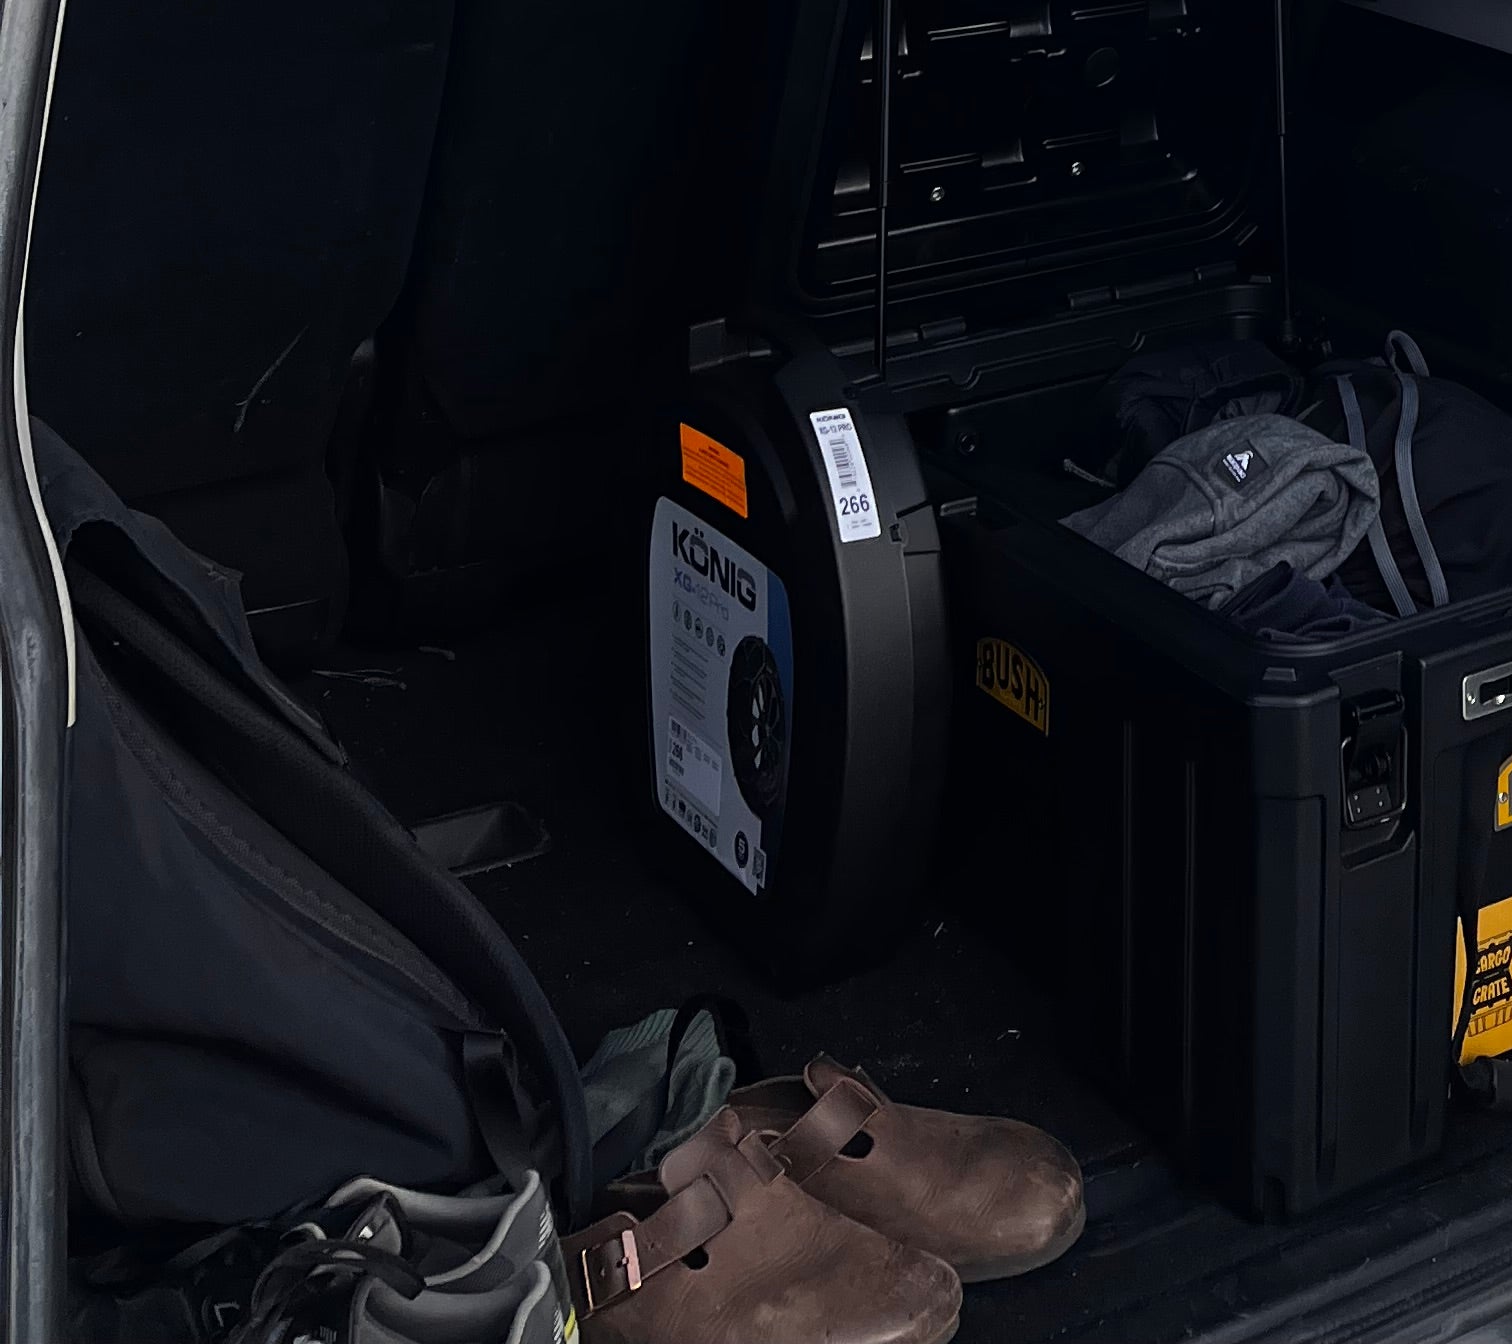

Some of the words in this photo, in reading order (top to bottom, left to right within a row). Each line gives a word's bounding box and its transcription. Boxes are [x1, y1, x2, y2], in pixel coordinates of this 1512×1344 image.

[840, 494, 870, 516] 266
[672, 520, 757, 612] KÖNIG
[982, 640, 1040, 722] BUSH
[1472, 976, 1510, 1006] CRATE
